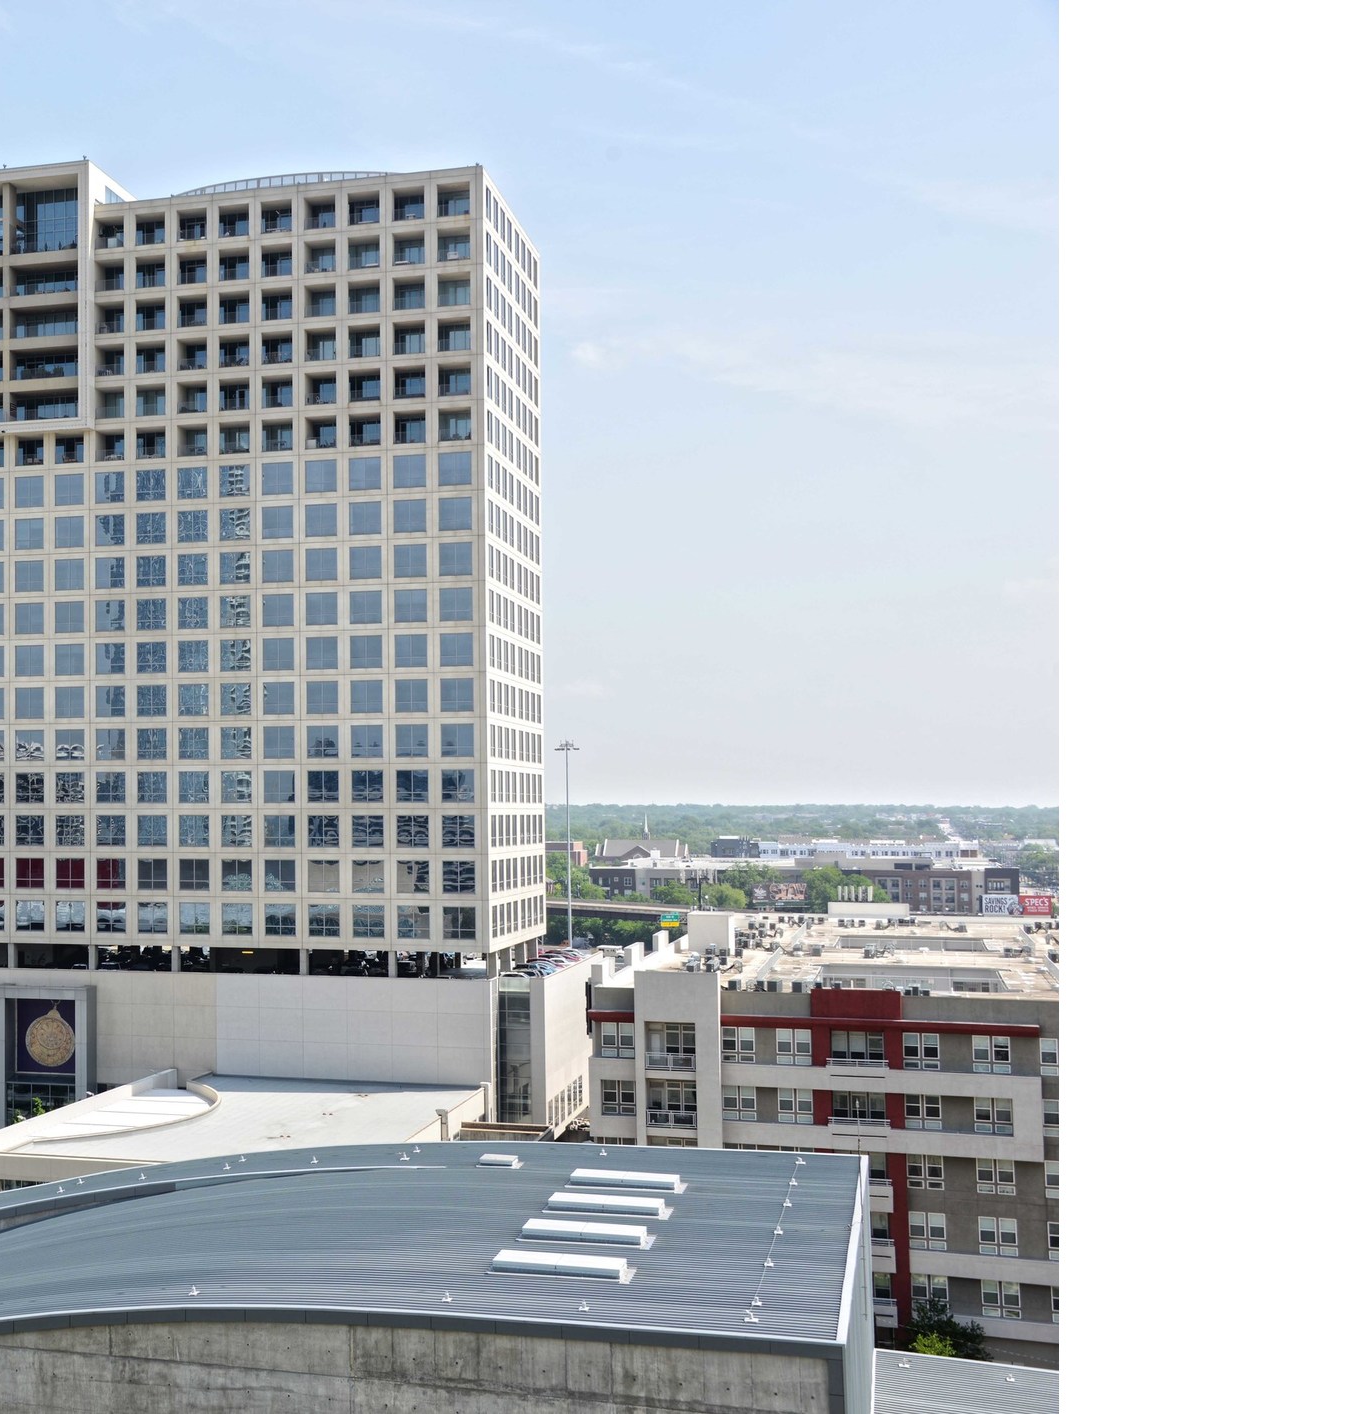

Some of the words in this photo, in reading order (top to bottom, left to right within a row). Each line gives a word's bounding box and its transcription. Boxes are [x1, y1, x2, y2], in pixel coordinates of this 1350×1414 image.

[984, 897, 1008, 905] SAVINGS
[1025, 897, 1049, 906] SPEC'S
[984, 905, 1006, 913] ROCK!
